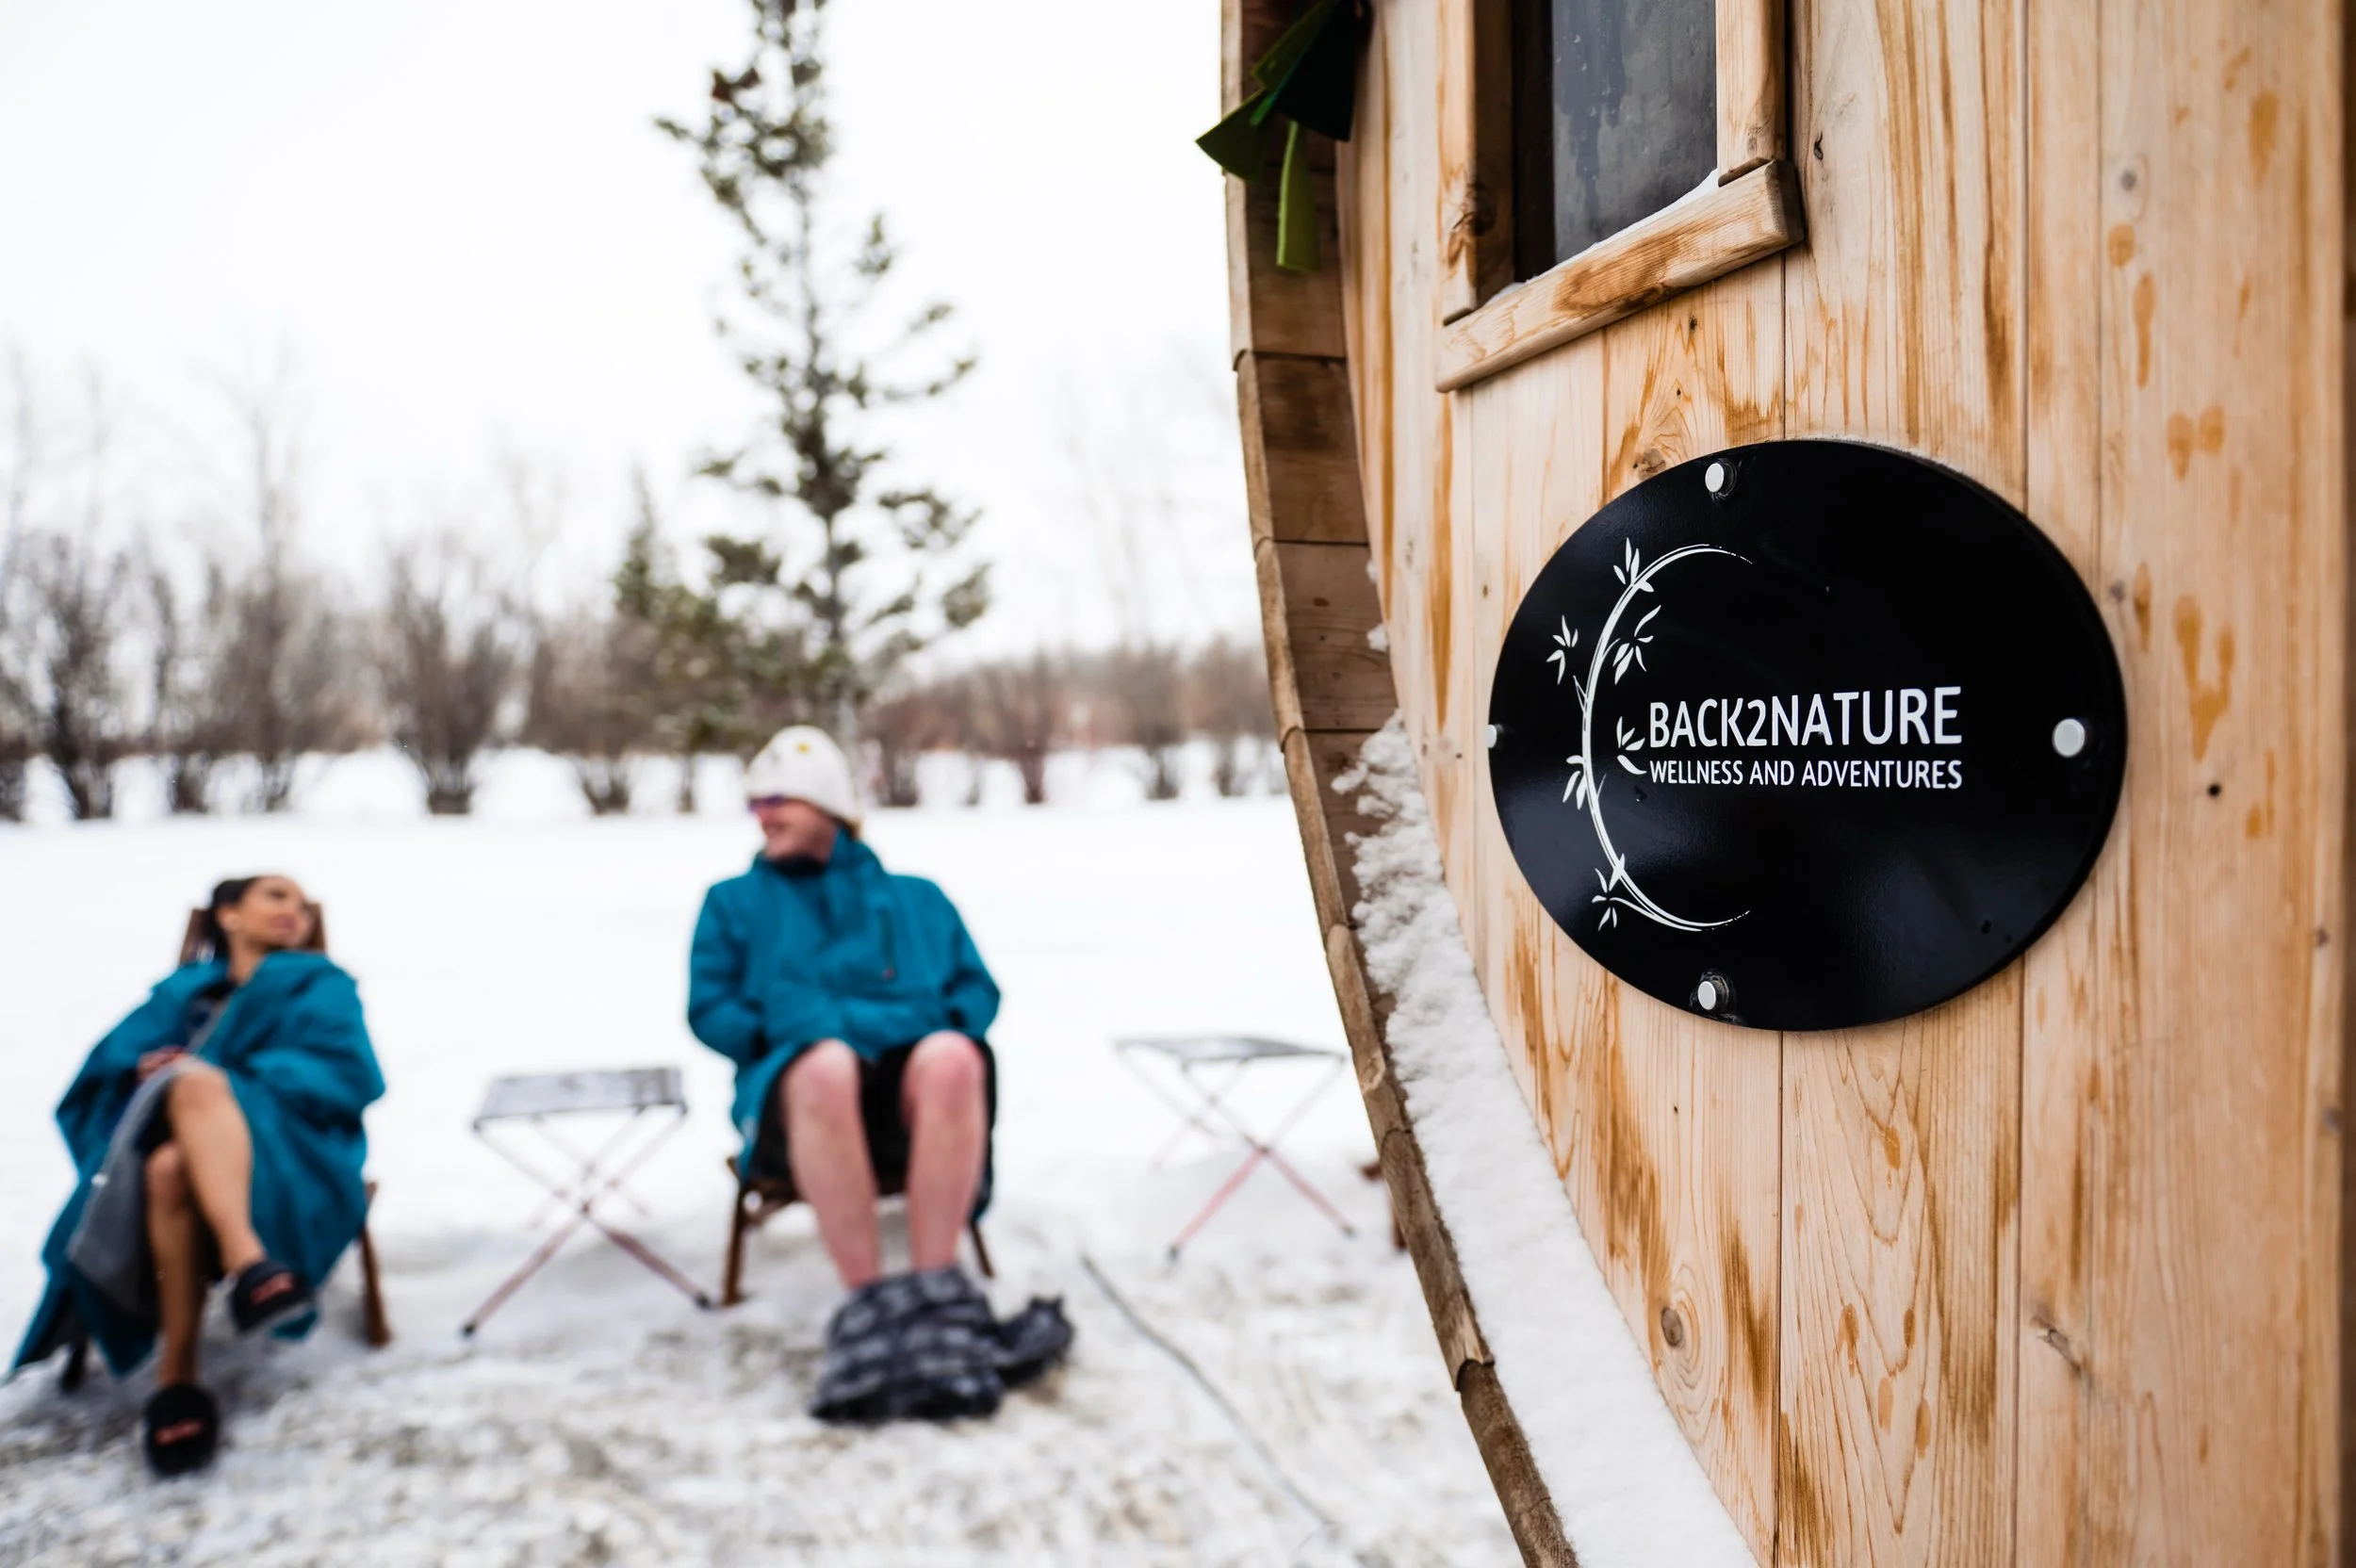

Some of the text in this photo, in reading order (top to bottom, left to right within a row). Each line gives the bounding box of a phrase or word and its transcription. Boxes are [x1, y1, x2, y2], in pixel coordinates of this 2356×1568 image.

[1649, 686, 1962, 748] BACK2NATURE
[1649, 760, 1962, 789] WELLNESS AND ADVENTURES
